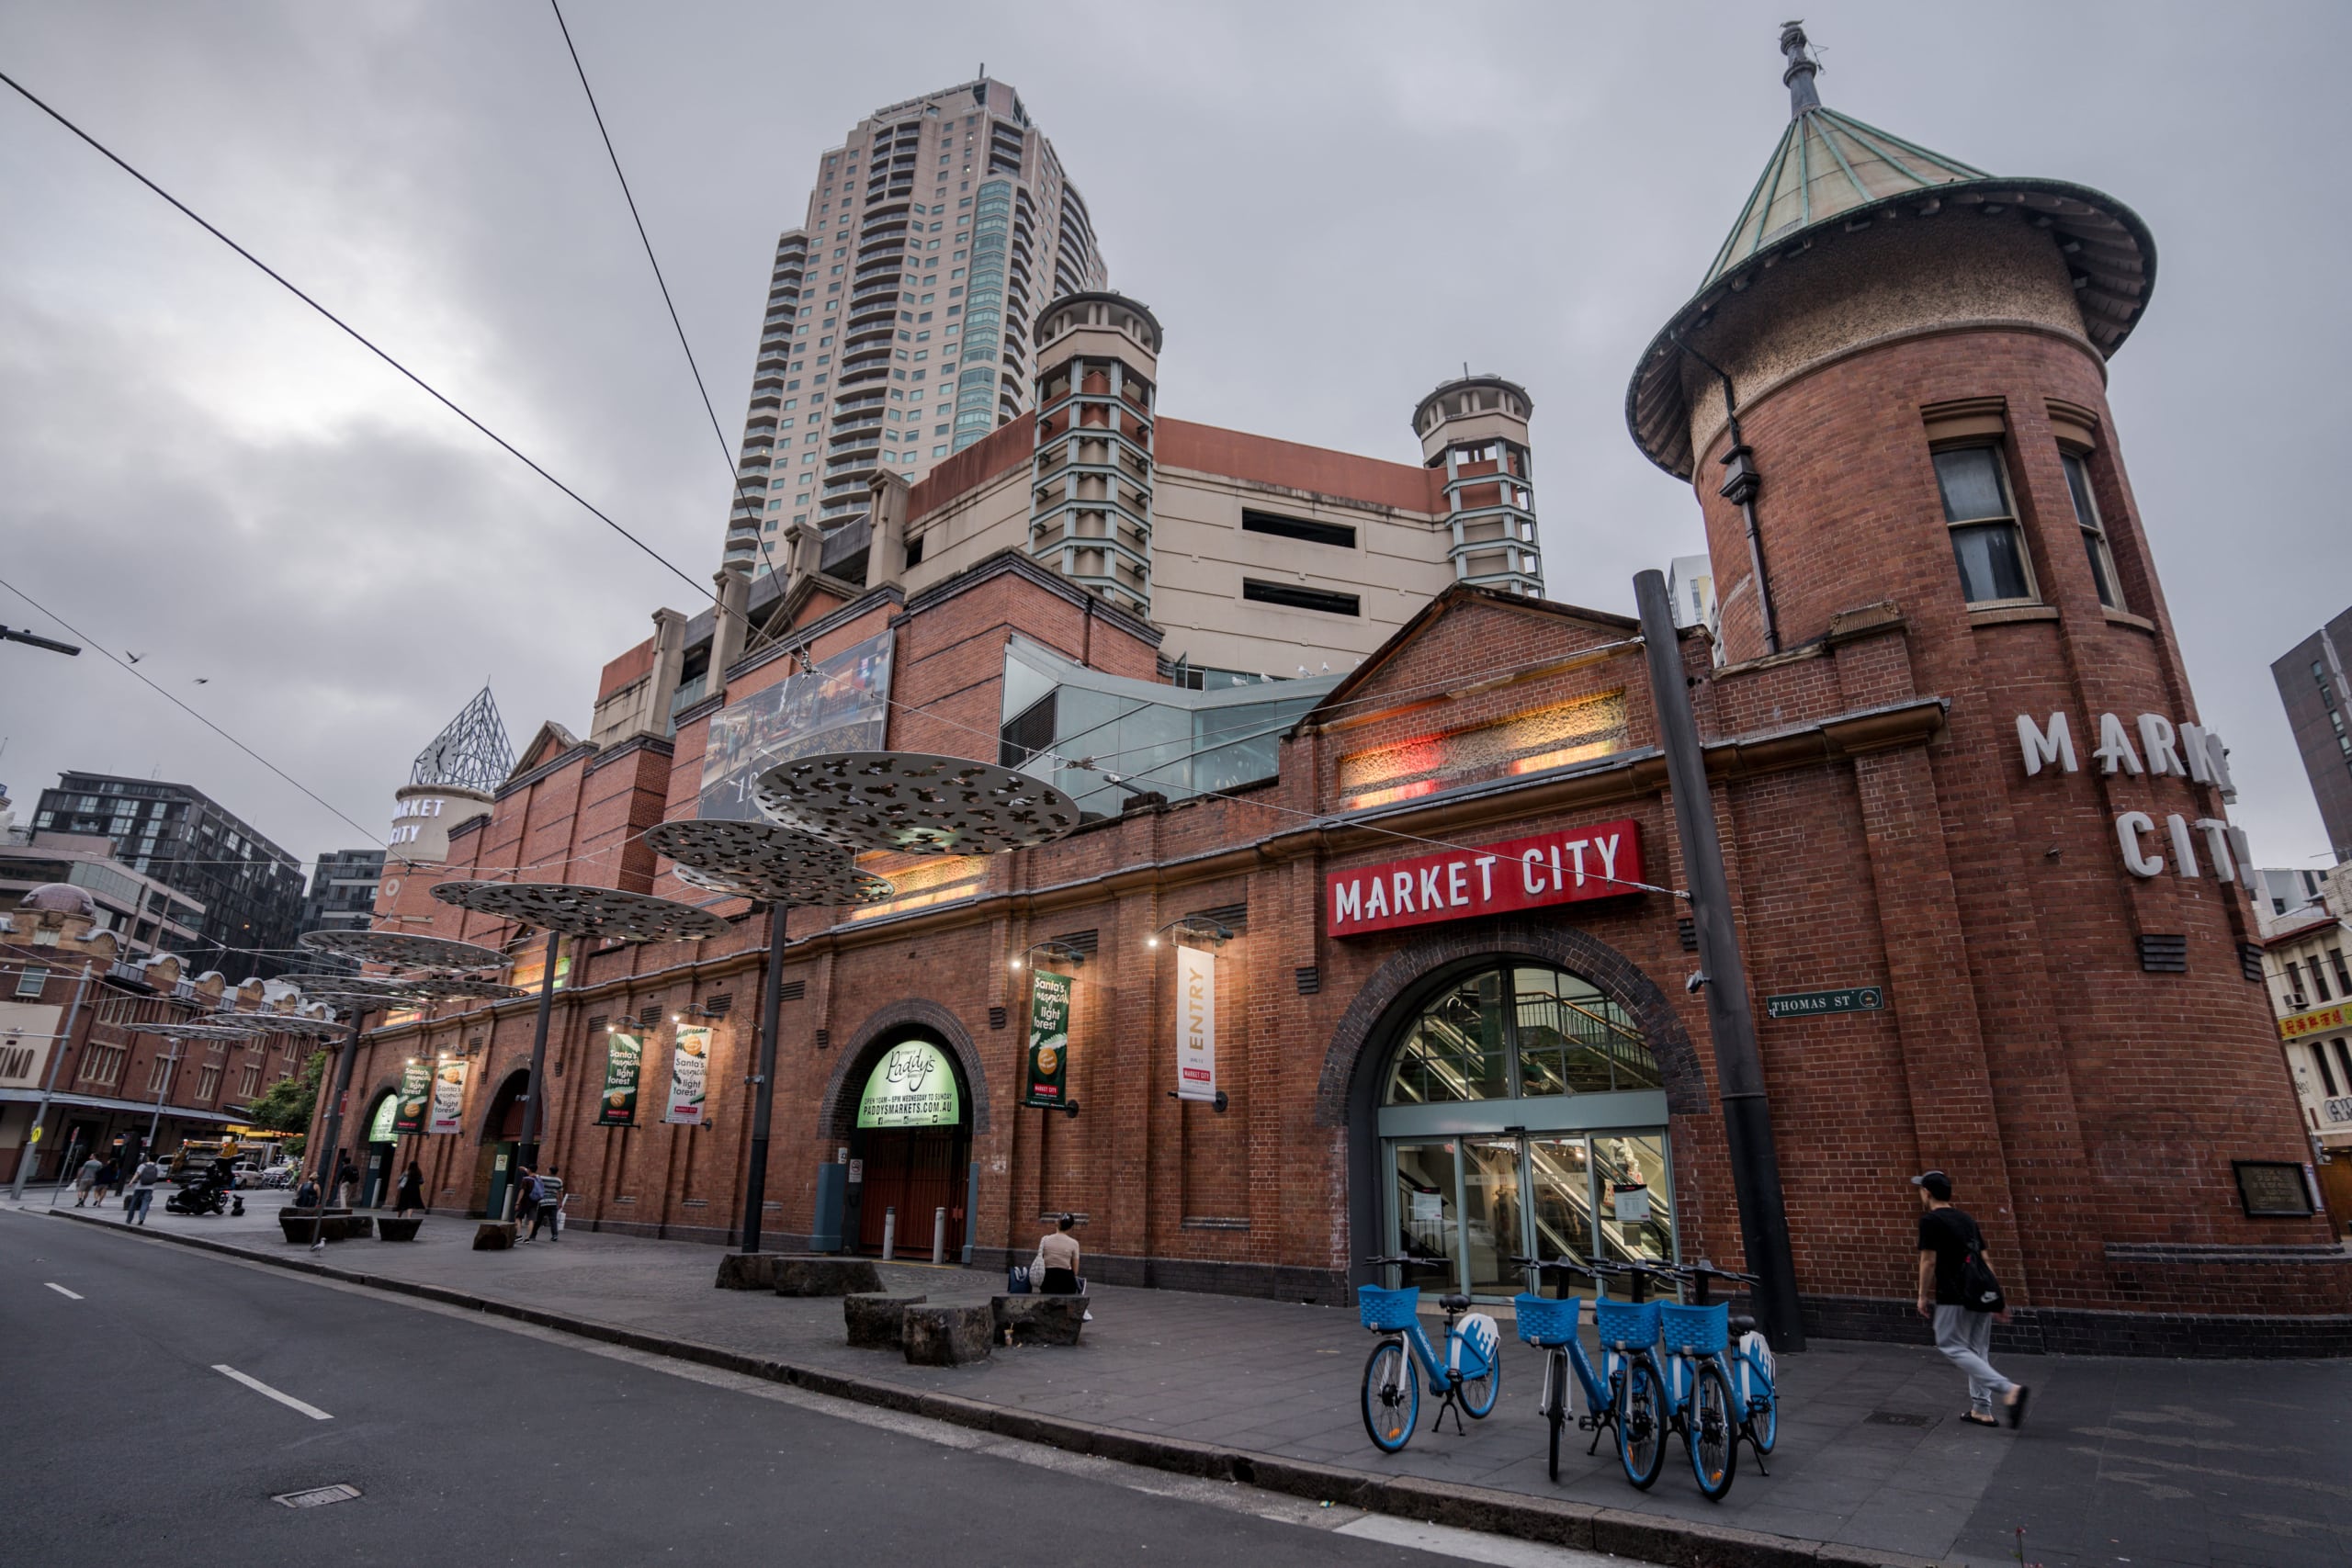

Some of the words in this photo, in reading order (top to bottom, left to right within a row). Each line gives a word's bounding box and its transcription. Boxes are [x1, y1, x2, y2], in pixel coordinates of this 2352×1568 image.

[2016, 711, 2238, 805] MARK
[1335, 855, 1497, 925] MARKET
[1521, 833, 1620, 896] CITY
[1035, 976, 1065, 994] Santa's
[1035, 989, 1069, 1010] magical
[1771, 998, 1826, 1012] THOMAS
[1834, 996, 1850, 1008] ST
[1040, 1006, 1061, 1021] light
[1189, 967, 1204, 1051] ENTRY
[1034, 1016, 1057, 1031] forest
[610, 1049, 638, 1059] Santa's
[675, 1057, 705, 1068] Santa's
[886, 1048, 935, 1092] Paddy's
[607, 1076, 630, 1085] forest
[616, 1068, 634, 1078] light
[1184, 1069, 1201, 1079] MARKET
[1201, 1072, 1210, 1080] CITY
[683, 1079, 701, 1089] light
[673, 1087, 696, 1097] forest
[902, 1094, 927, 1102] WEDNESDAY
[928, 1093, 934, 1101] TO
[934, 1092, 953, 1100] SUNDAY
[864, 1101, 952, 1116] PADDYSMARKETS.COM.AU
